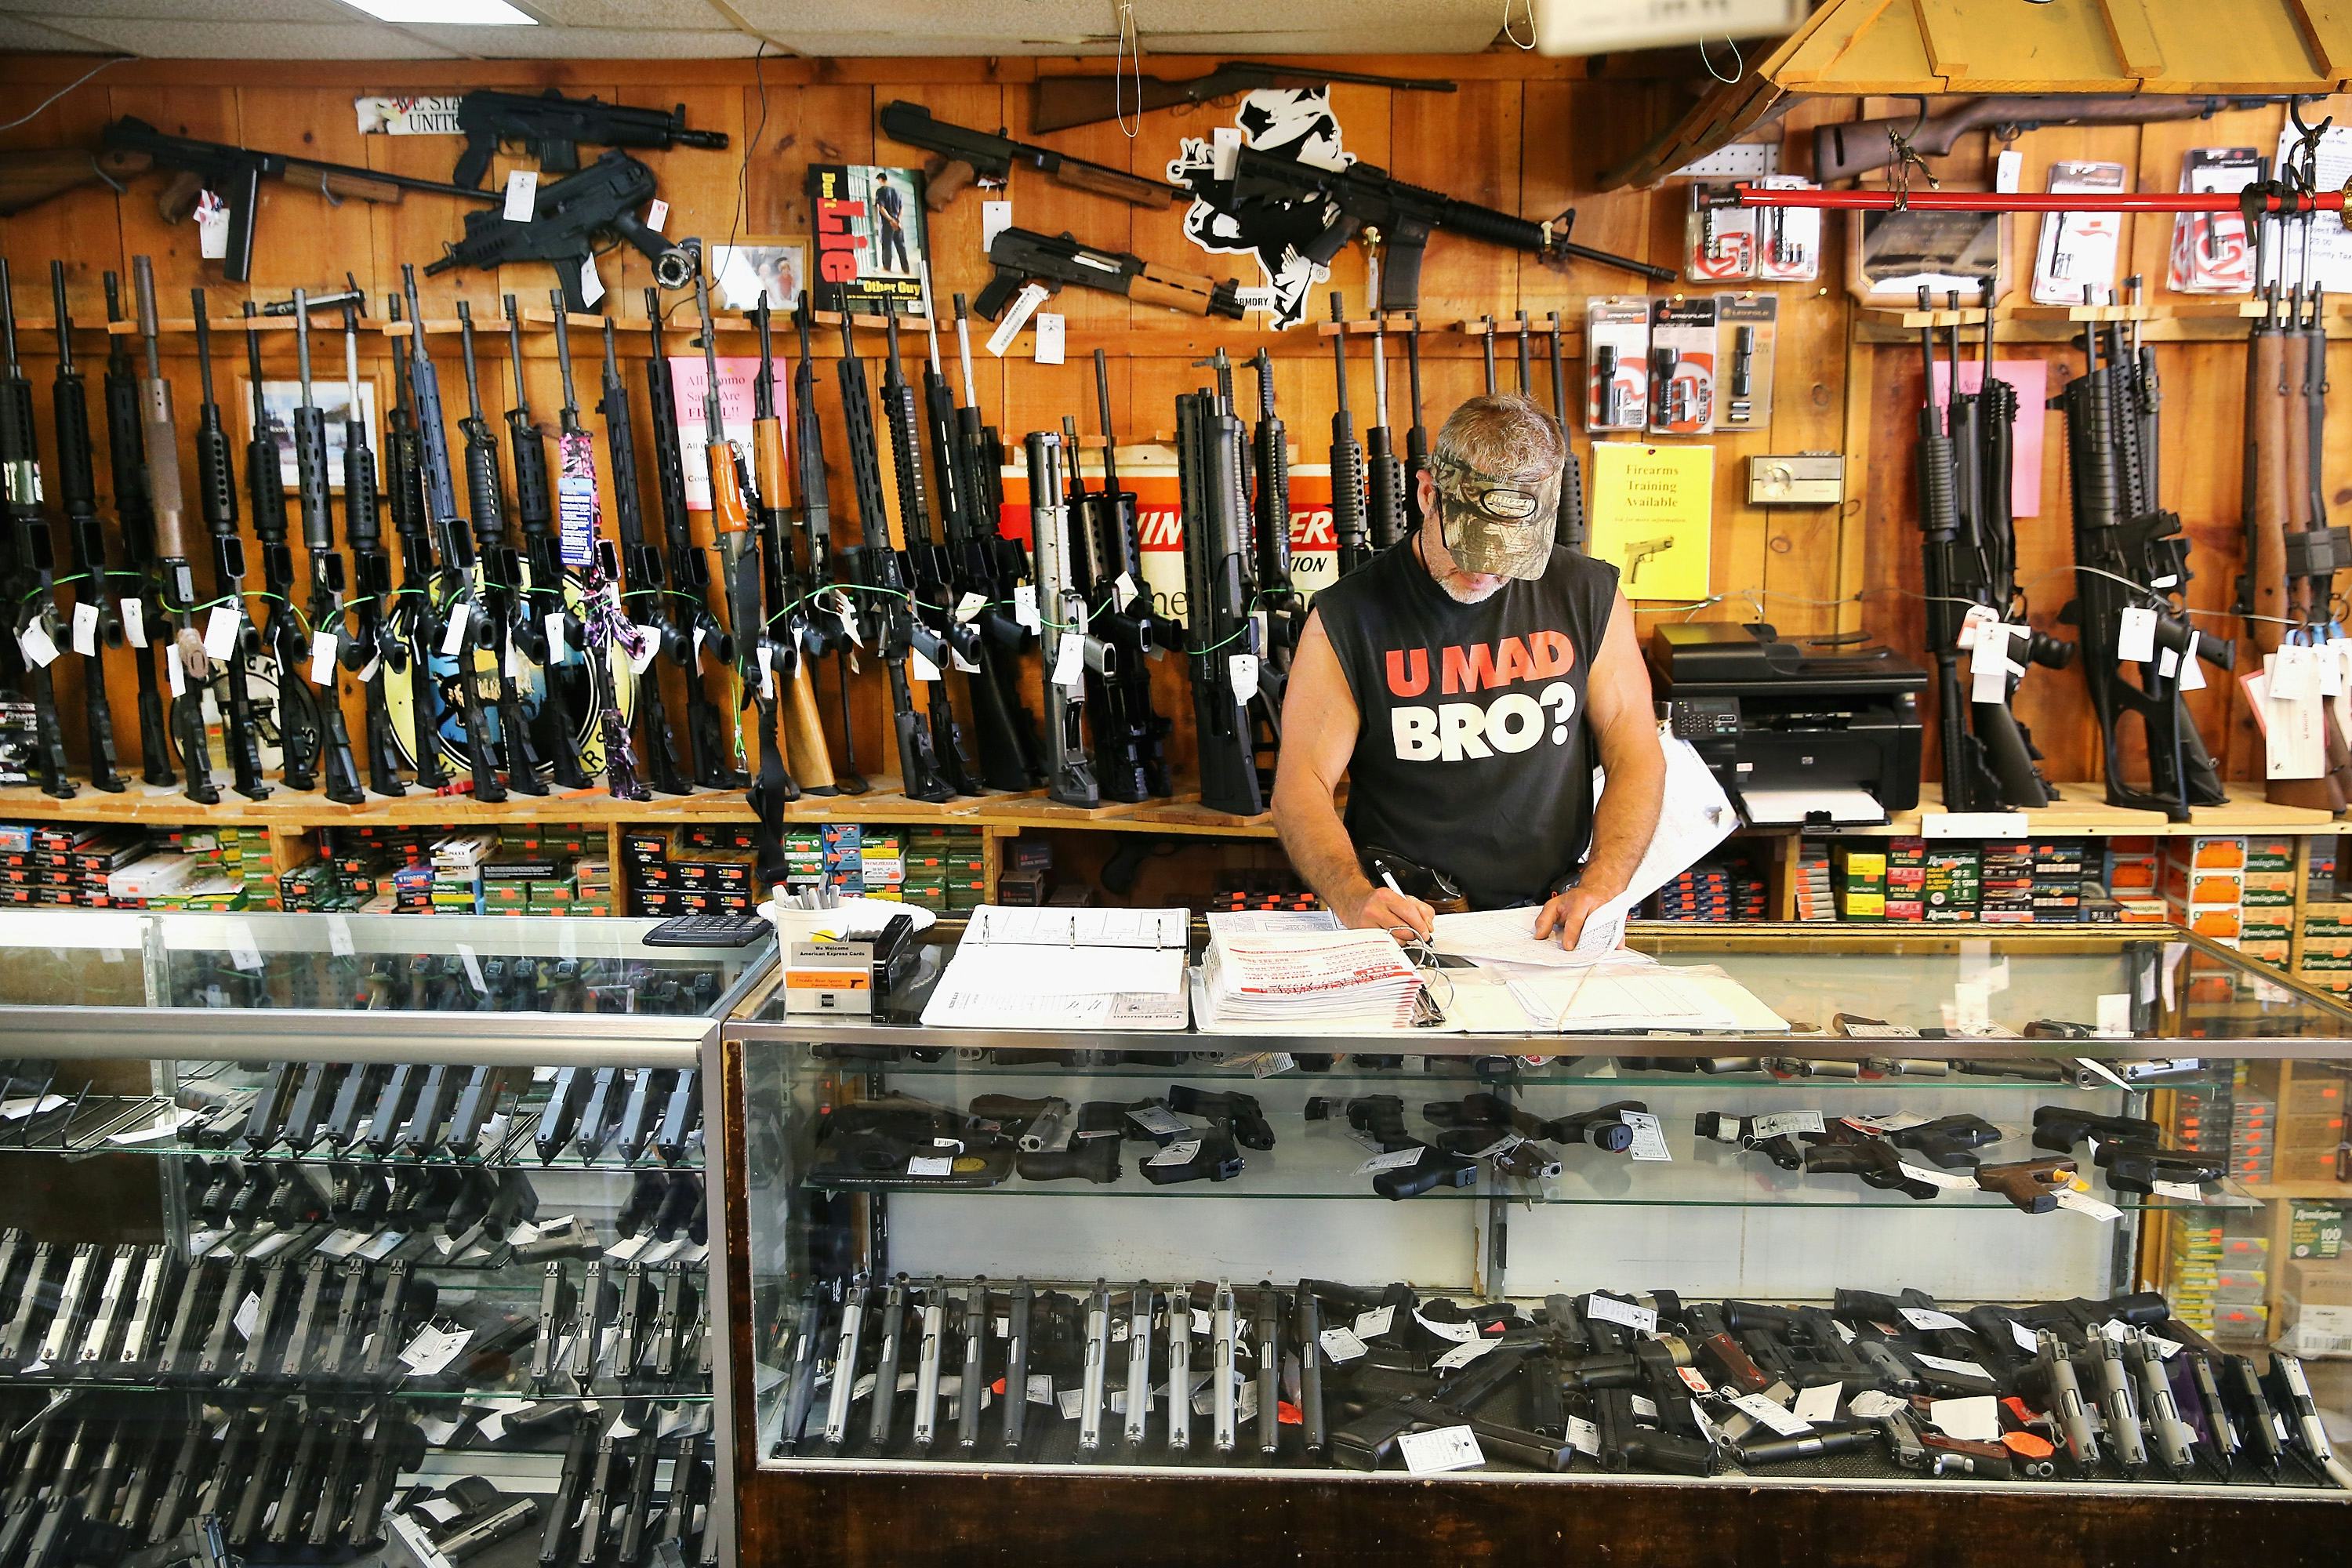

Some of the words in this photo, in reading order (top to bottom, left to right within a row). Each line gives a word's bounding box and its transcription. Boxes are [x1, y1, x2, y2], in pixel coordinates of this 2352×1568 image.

[430, 96, 462, 111] STA
[409, 114, 459, 132] UNIT
[817, 198, 869, 283] Lie
[862, 279, 897, 294] Other
[897, 280, 922, 296] Guy
[687, 376, 703, 387] All
[688, 407, 740, 418] FIL!!
[1626, 464, 1679, 475] Firearms
[1628, 480, 1677, 492] Training
[1624, 497, 1679, 508] Available
[1385, 648, 1430, 698] U
[1441, 630, 1574, 695] MAD
[1391, 681, 1577, 762] BRO?
[2245, 858, 2285, 869] emington
[1926, 909, 1975, 921] Remingn
[2321, 1228, 2343, 1241] 100
